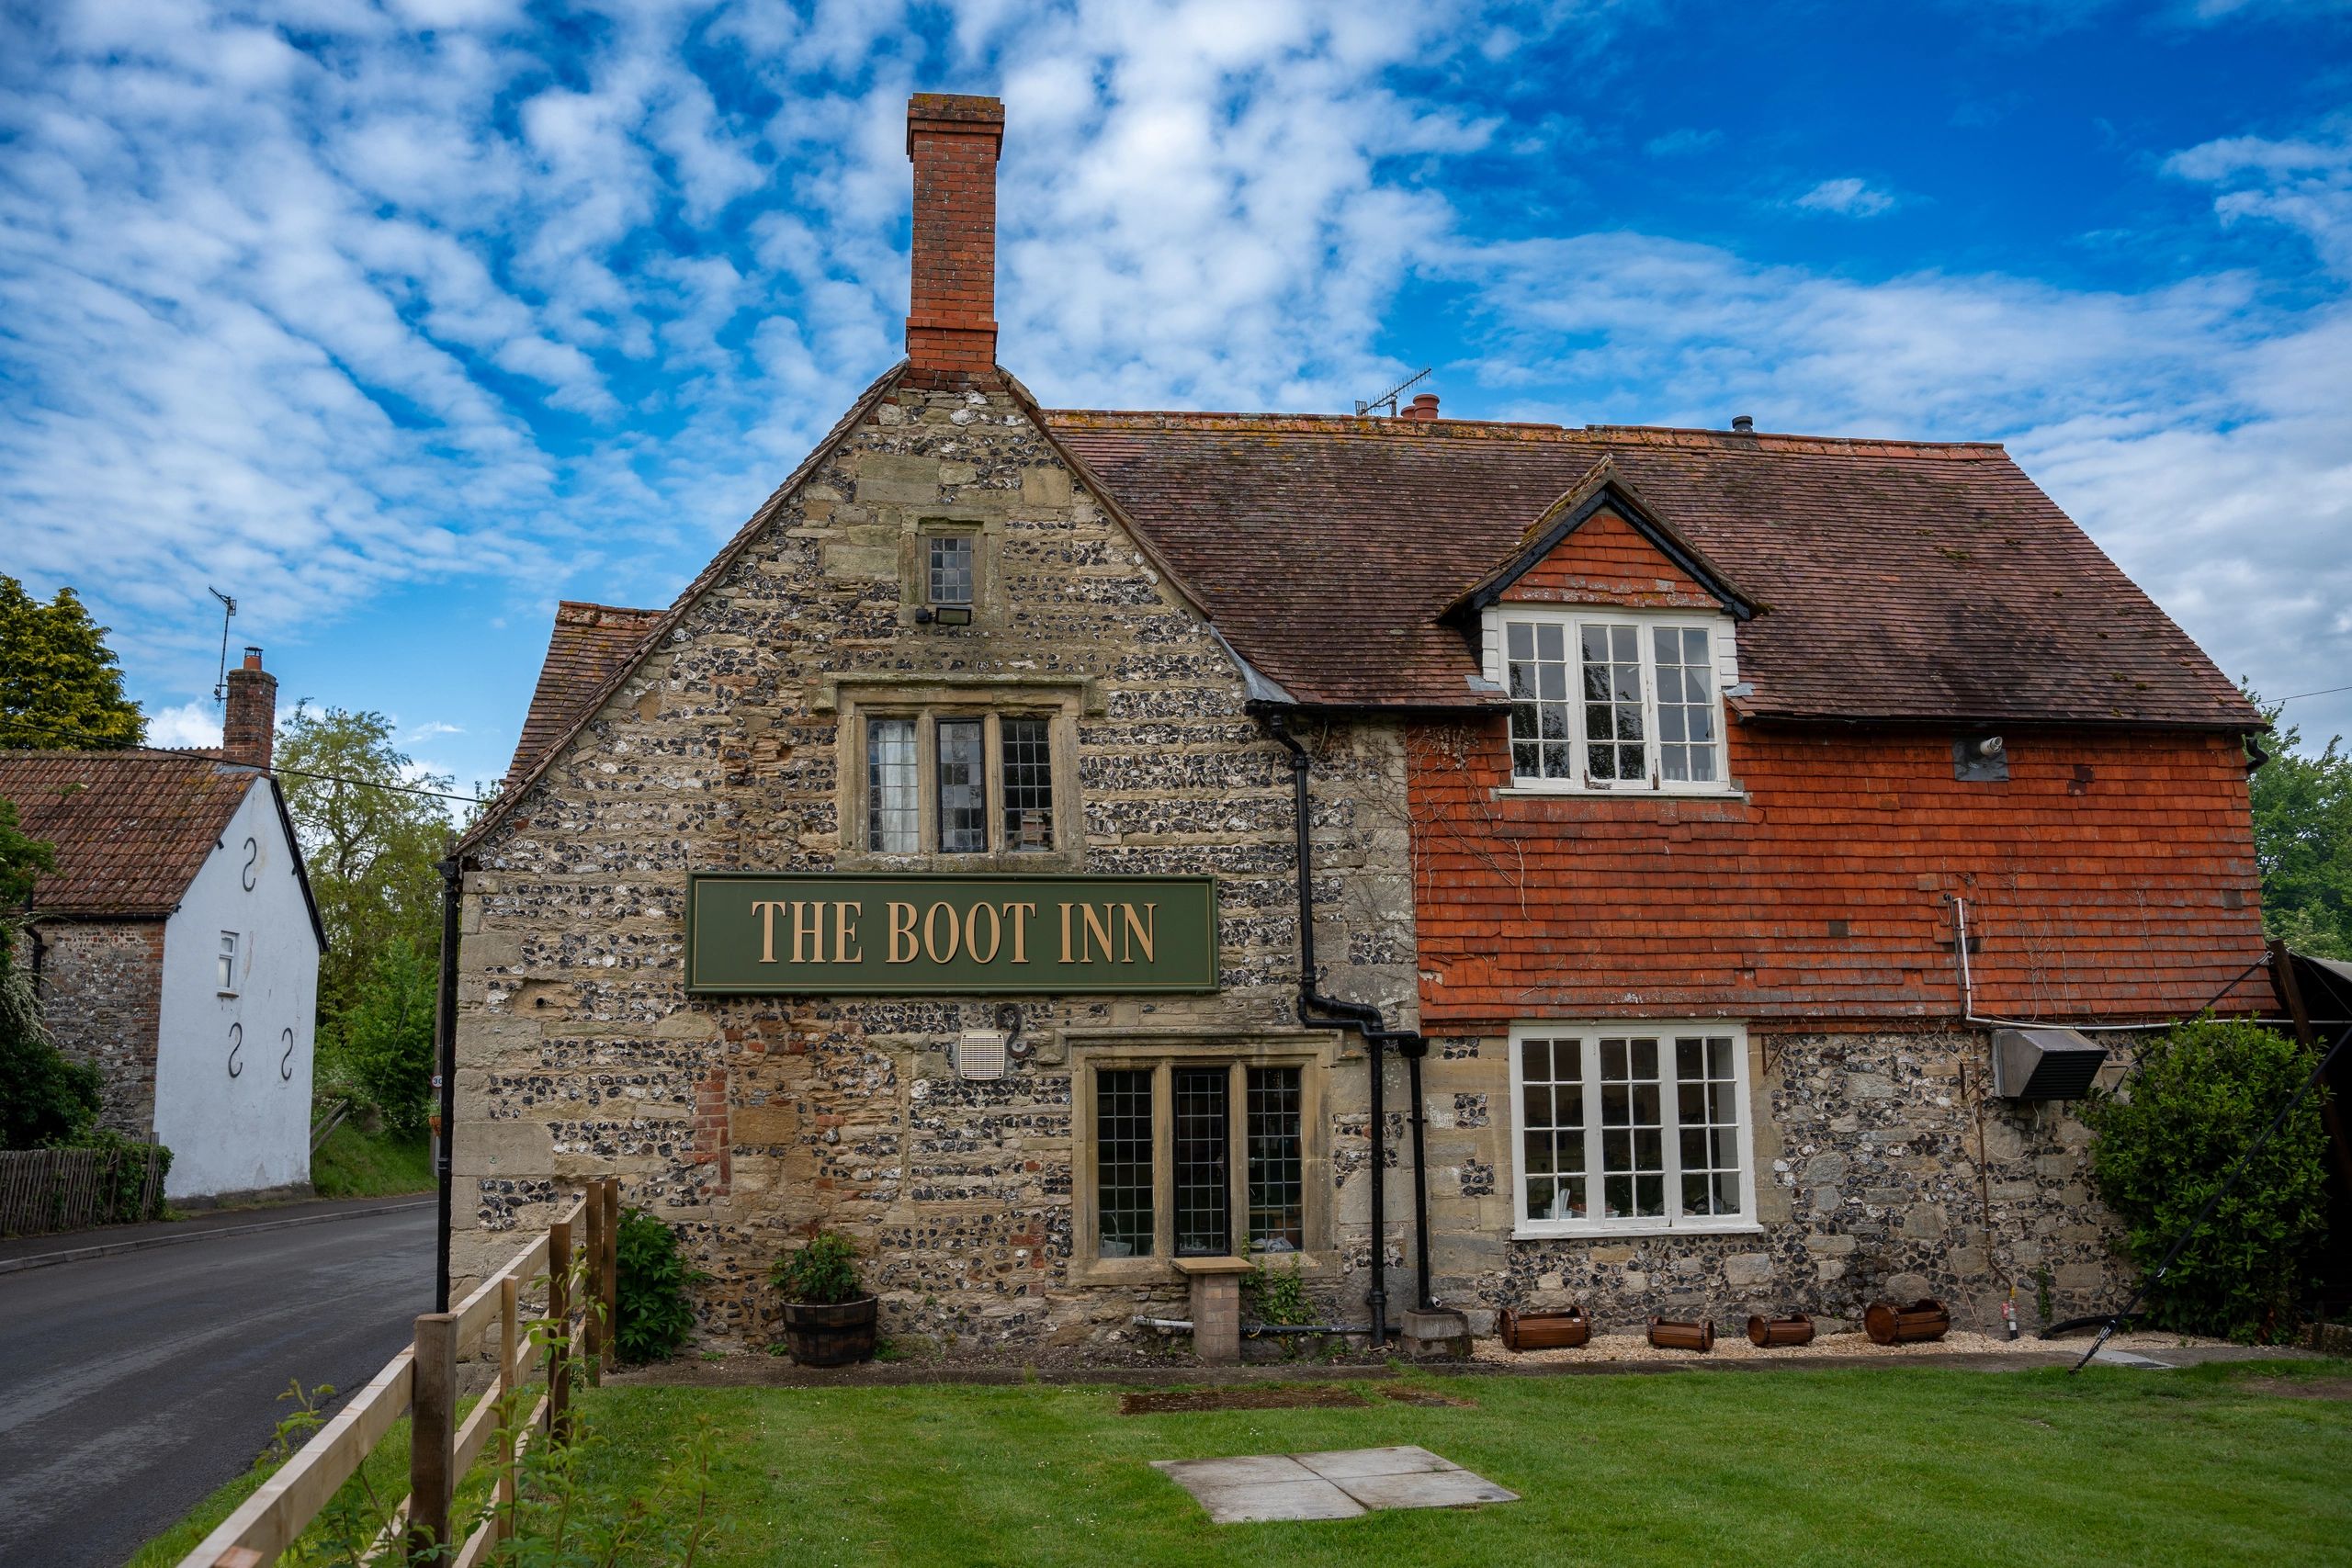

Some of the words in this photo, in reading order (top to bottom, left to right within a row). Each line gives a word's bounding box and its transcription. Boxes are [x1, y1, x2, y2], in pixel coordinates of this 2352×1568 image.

[752, 901, 863, 963] THE
[885, 901, 1036, 964] BOOT
[1057, 903, 1158, 964] INN
